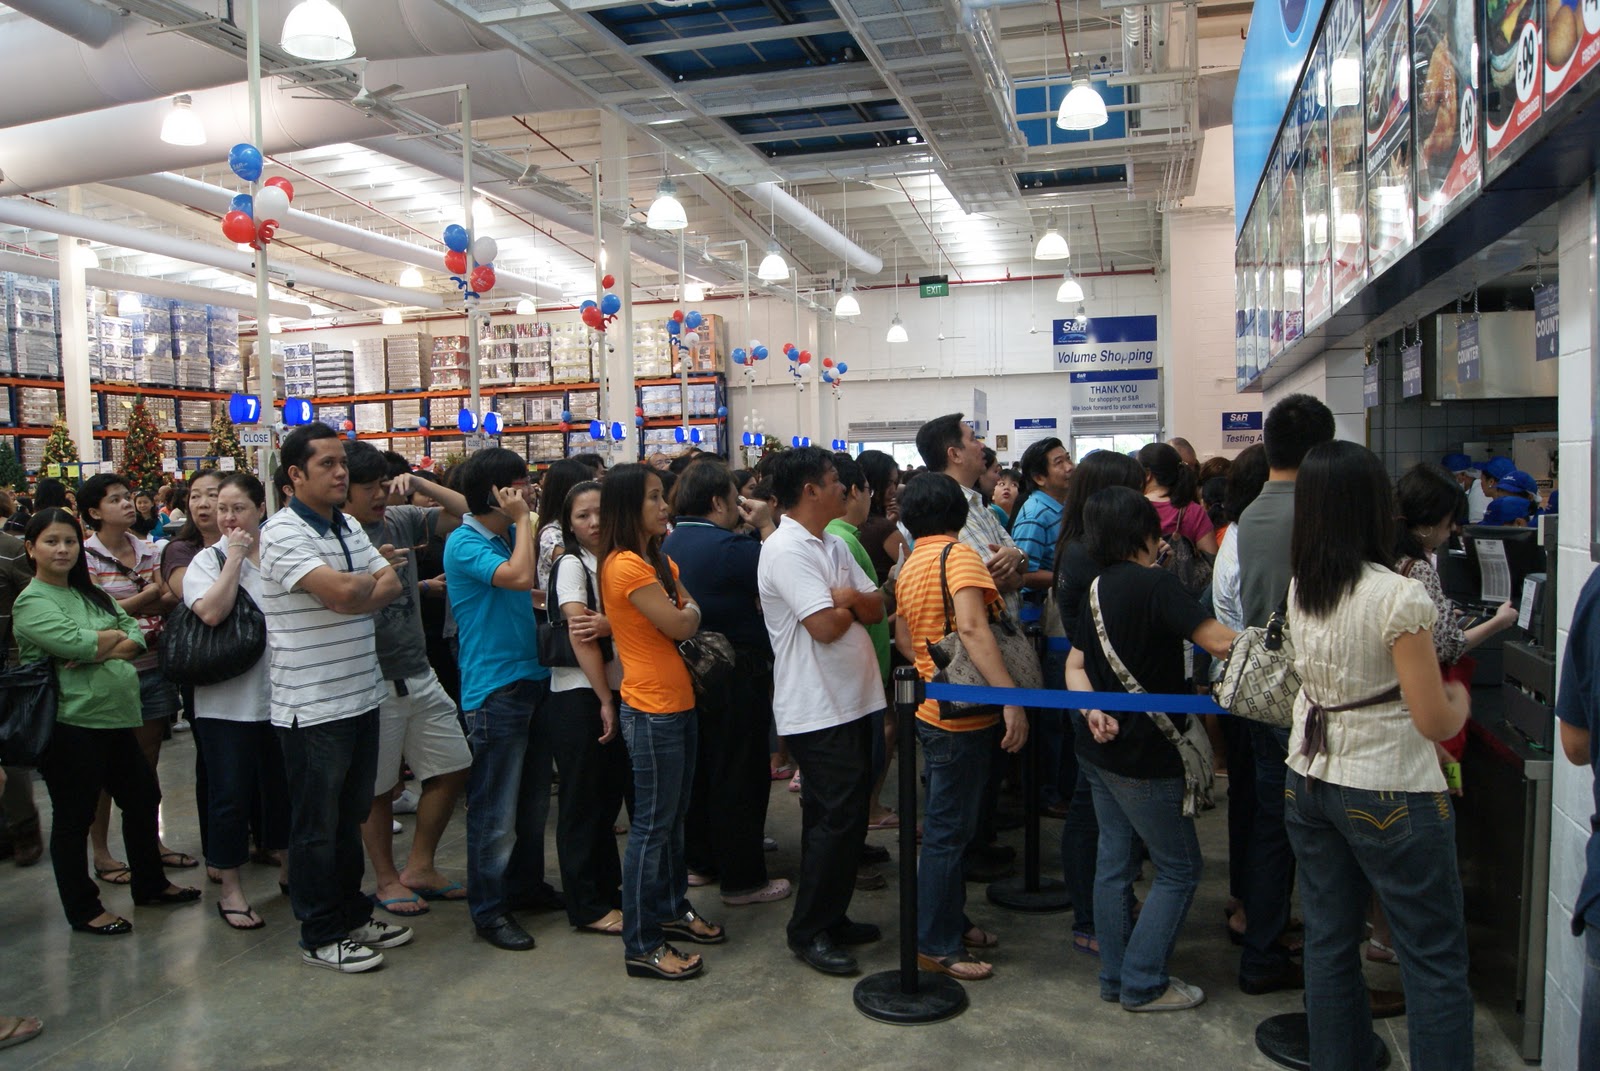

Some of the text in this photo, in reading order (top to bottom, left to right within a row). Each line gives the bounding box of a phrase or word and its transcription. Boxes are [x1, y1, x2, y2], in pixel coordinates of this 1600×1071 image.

[926, 285, 943, 295] EXIT
[1062, 321, 1088, 331] S&R
[1536, 315, 1559, 338] COUNT
[1550, 338, 1555, 354] 4
[1058, 348, 1153, 364] Volume Shopping
[1458, 345, 1479, 364] COUNTER
[1090, 384, 1137, 394] THANK YOU
[247, 398, 256, 419] 7
[302, 401, 310, 421] 8
[1230, 413, 1248, 422] S&R
[243, 433, 268, 443] CLOSE
[1226, 434, 1255, 444] Testing
